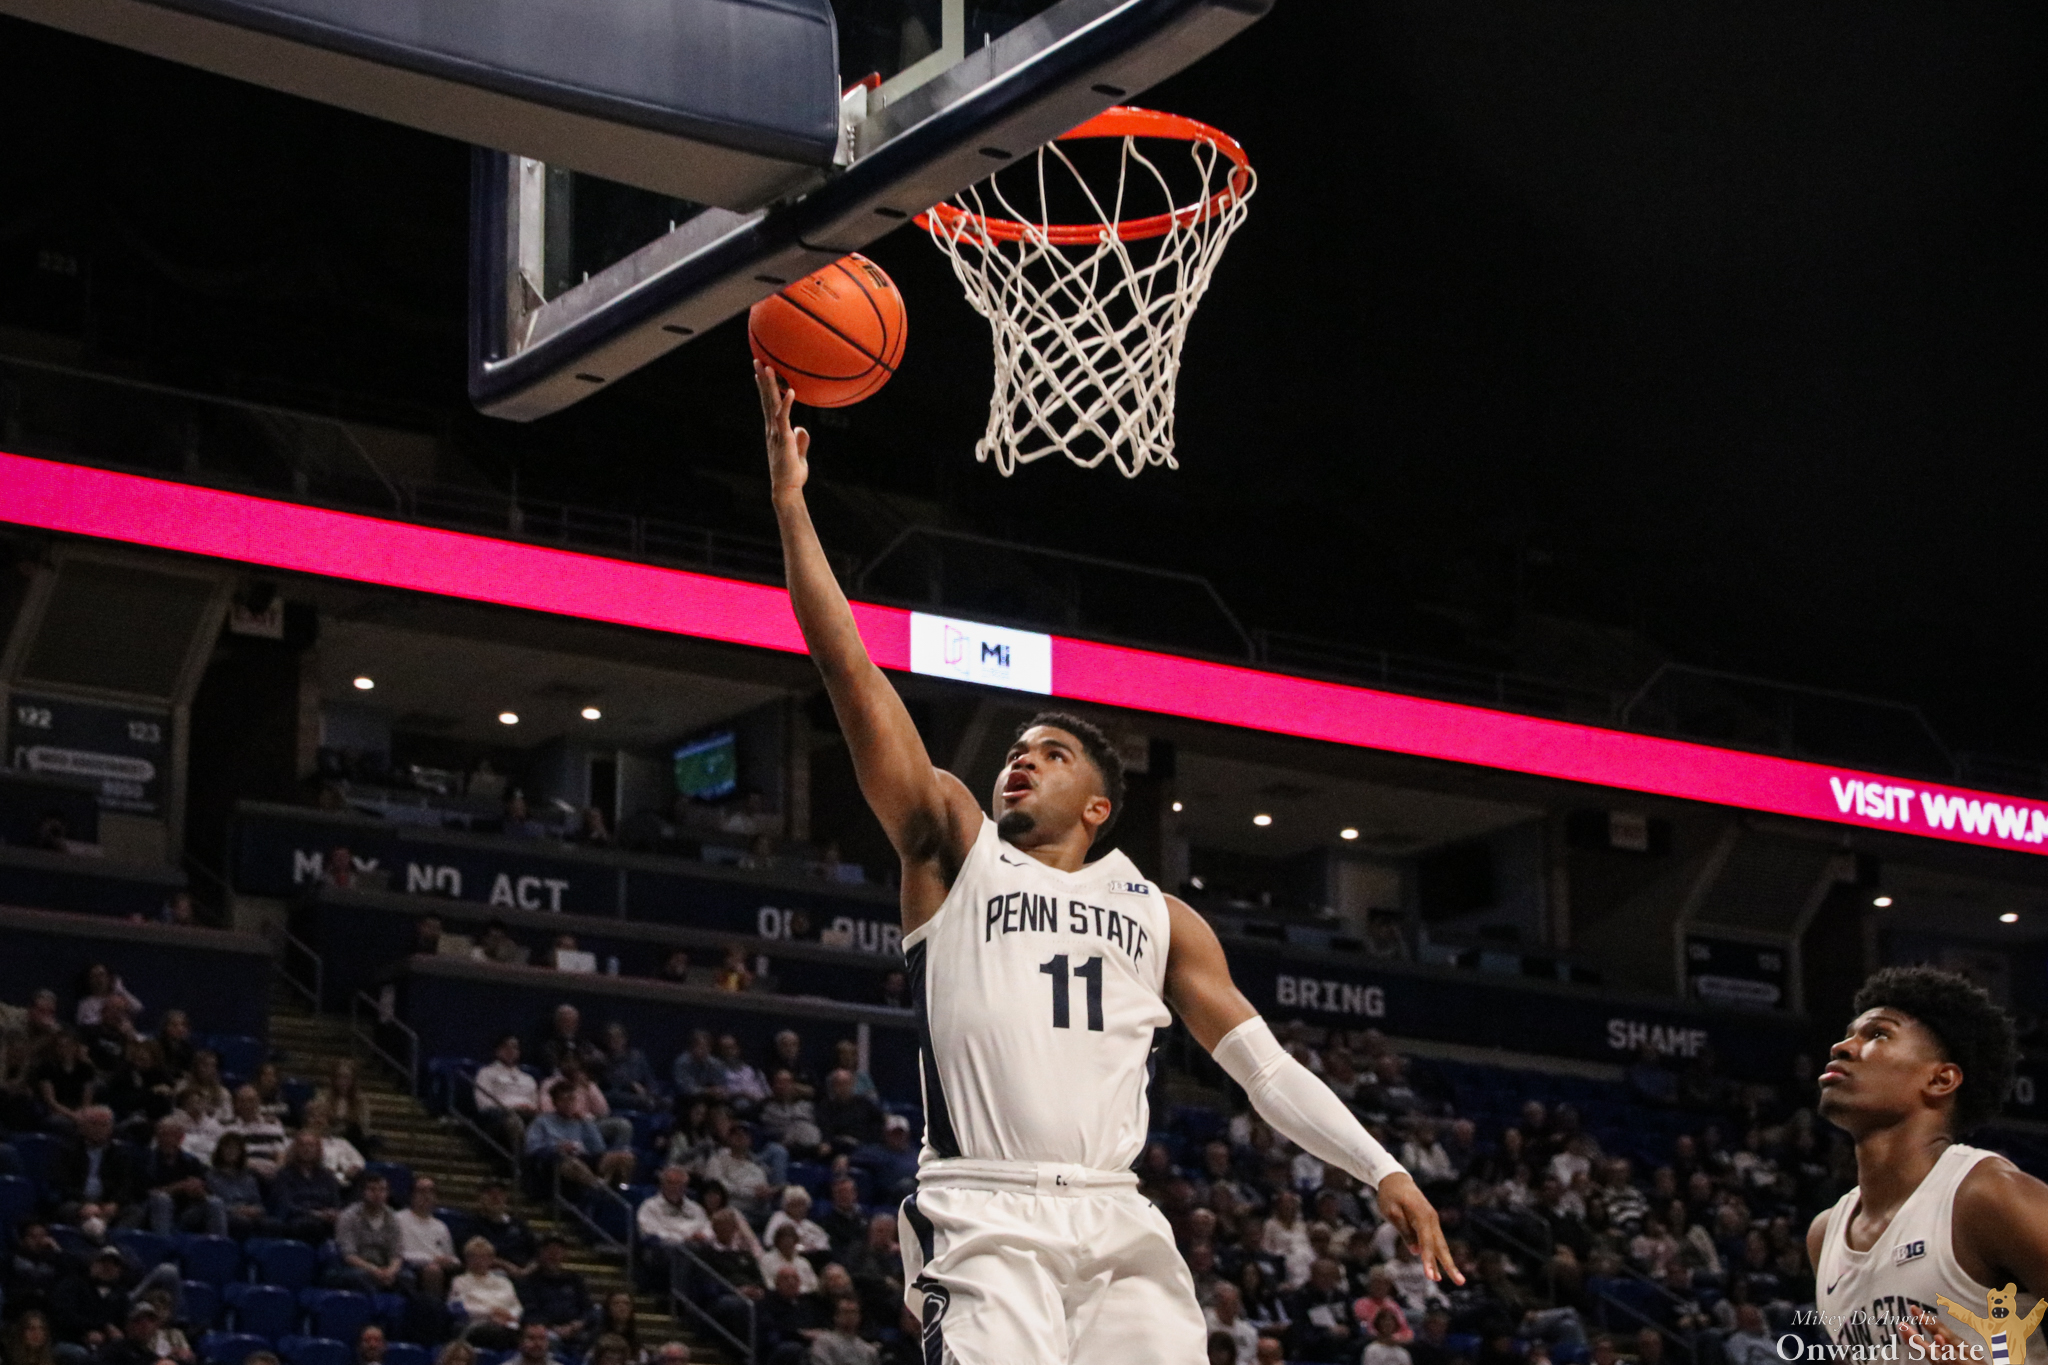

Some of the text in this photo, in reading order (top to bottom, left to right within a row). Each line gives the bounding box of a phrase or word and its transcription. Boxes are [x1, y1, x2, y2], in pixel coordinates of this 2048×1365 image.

[981, 641, 1010, 667] Mi
[1829, 776, 1915, 823] VISIT
[293, 848, 570, 913] MY NO ACT
[985, 891, 1148, 974] PENN STATE
[1039, 953, 1105, 1032] 11
[1276, 974, 1386, 1018] BRING
